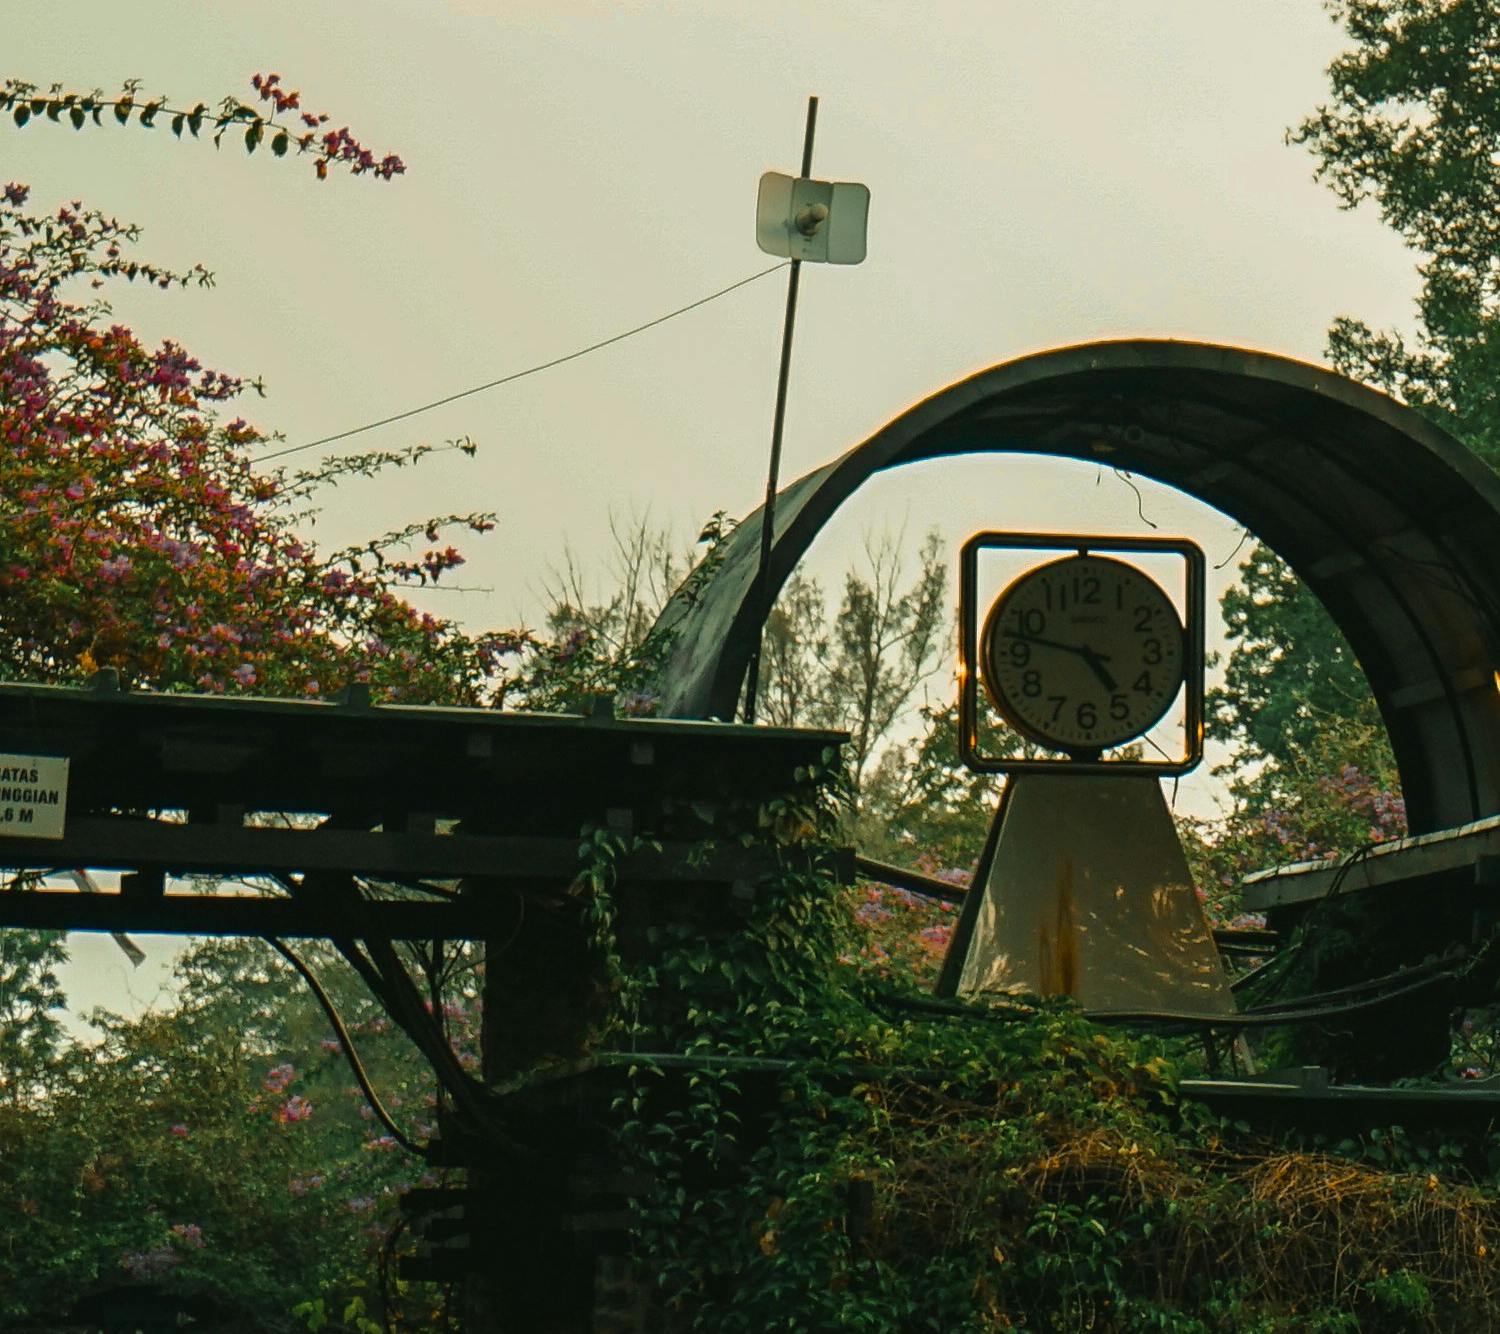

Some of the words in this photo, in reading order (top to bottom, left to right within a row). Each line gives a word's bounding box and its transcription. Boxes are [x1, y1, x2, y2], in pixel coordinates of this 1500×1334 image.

[1046, 584, 1066, 610] 11
[1074, 577, 1101, 604] 12
[1117, 584, 1122, 610] 1
[1019, 609, 1045, 635] 10
[1134, 605, 1152, 632] 2
[1010, 641, 1031, 667] 9
[1142, 639, 1162, 665] 3
[1022, 670, 1041, 697] 8
[1133, 670, 1152, 696] 4
[1047, 696, 1067, 721] 7
[1077, 703, 1097, 730] 6
[1110, 694, 1129, 720] 5
[0, 767, 38, 783] ATAS
[0, 786, 59, 805] NGGIAN
[19, 808, 33, 823] M
